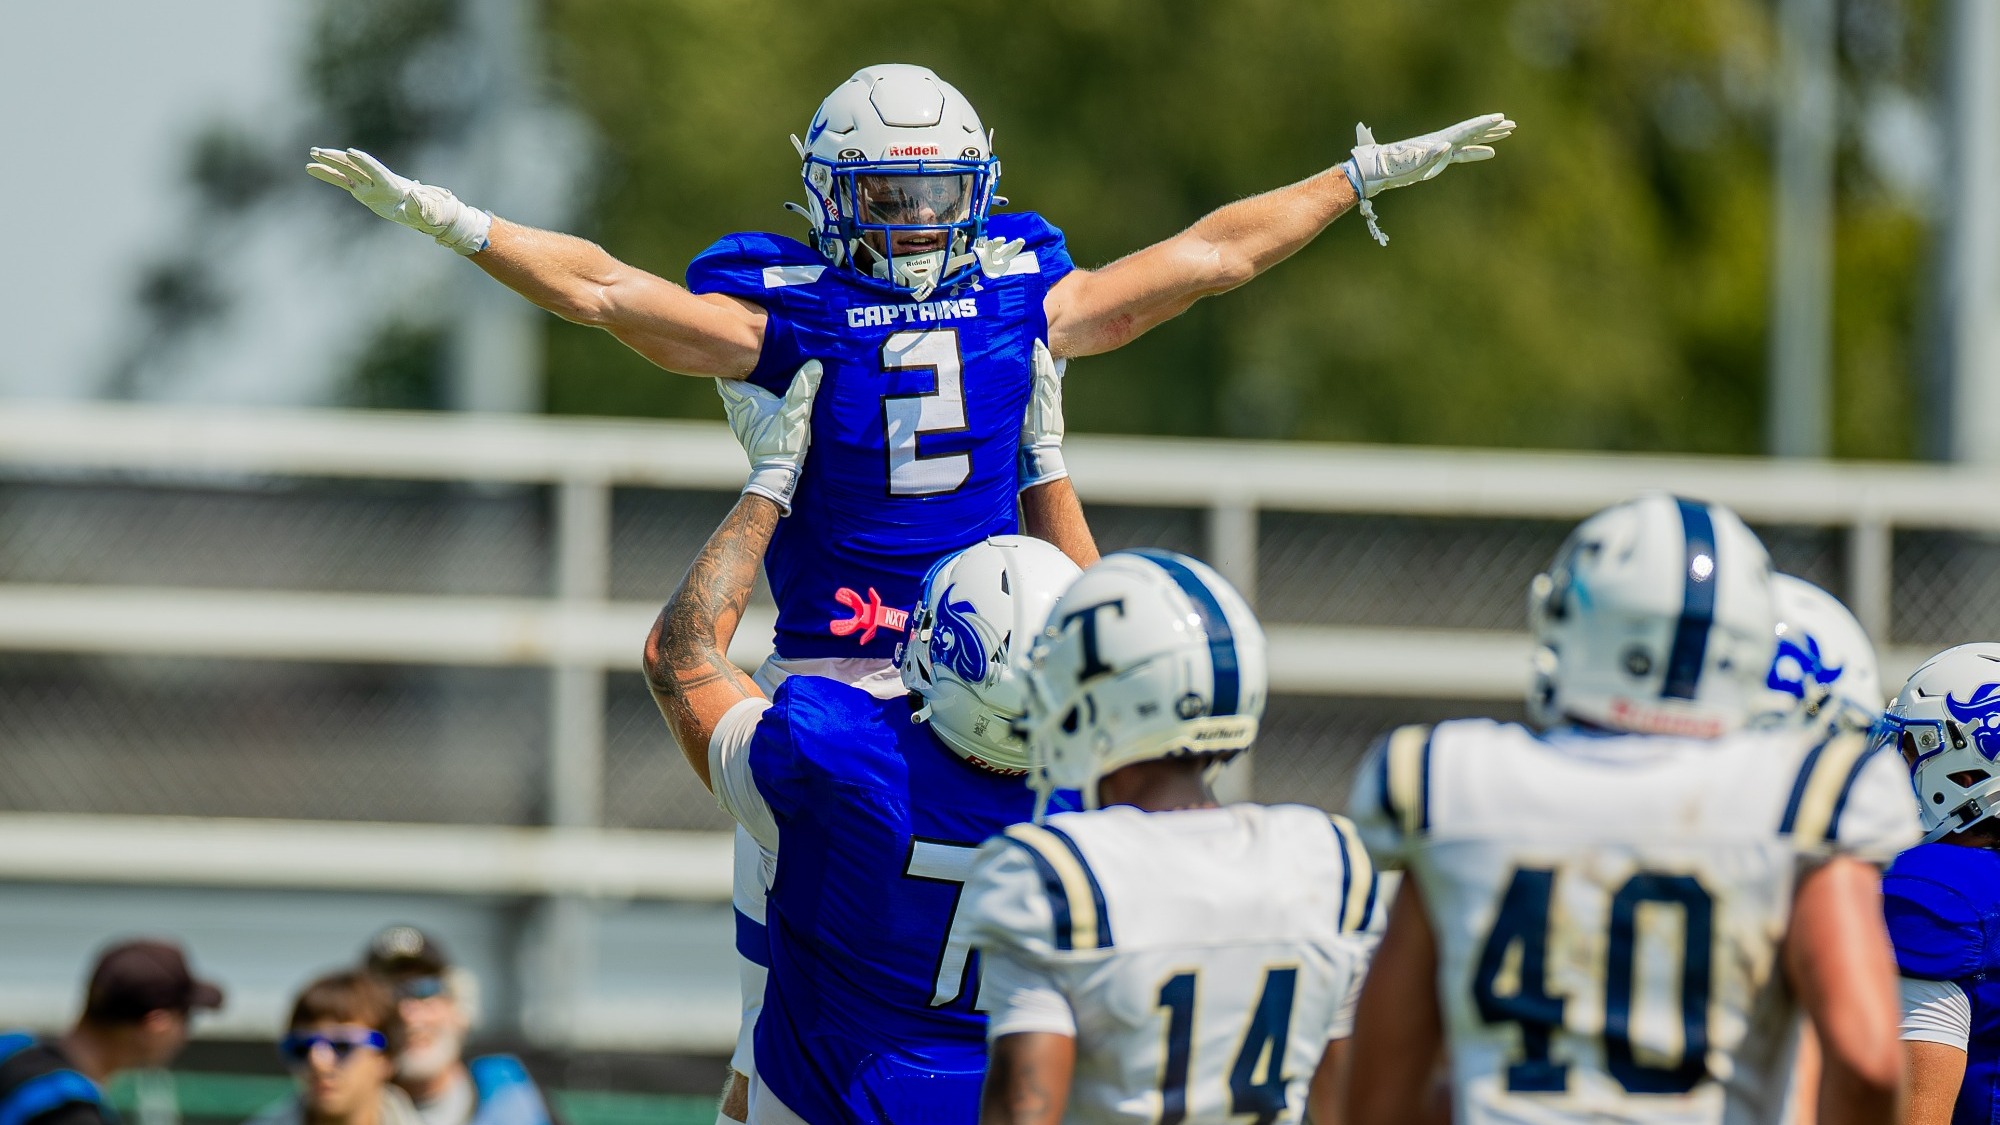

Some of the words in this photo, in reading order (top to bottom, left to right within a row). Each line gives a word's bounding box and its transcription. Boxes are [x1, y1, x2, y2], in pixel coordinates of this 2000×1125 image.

[846, 298, 977, 328] CAPTAINS
[878, 328, 974, 497] 2
[1060, 598, 1125, 684] T
[904, 834, 990, 1014] 7
[1472, 868, 1714, 1095] 40
[1154, 964, 1300, 1125] 14
